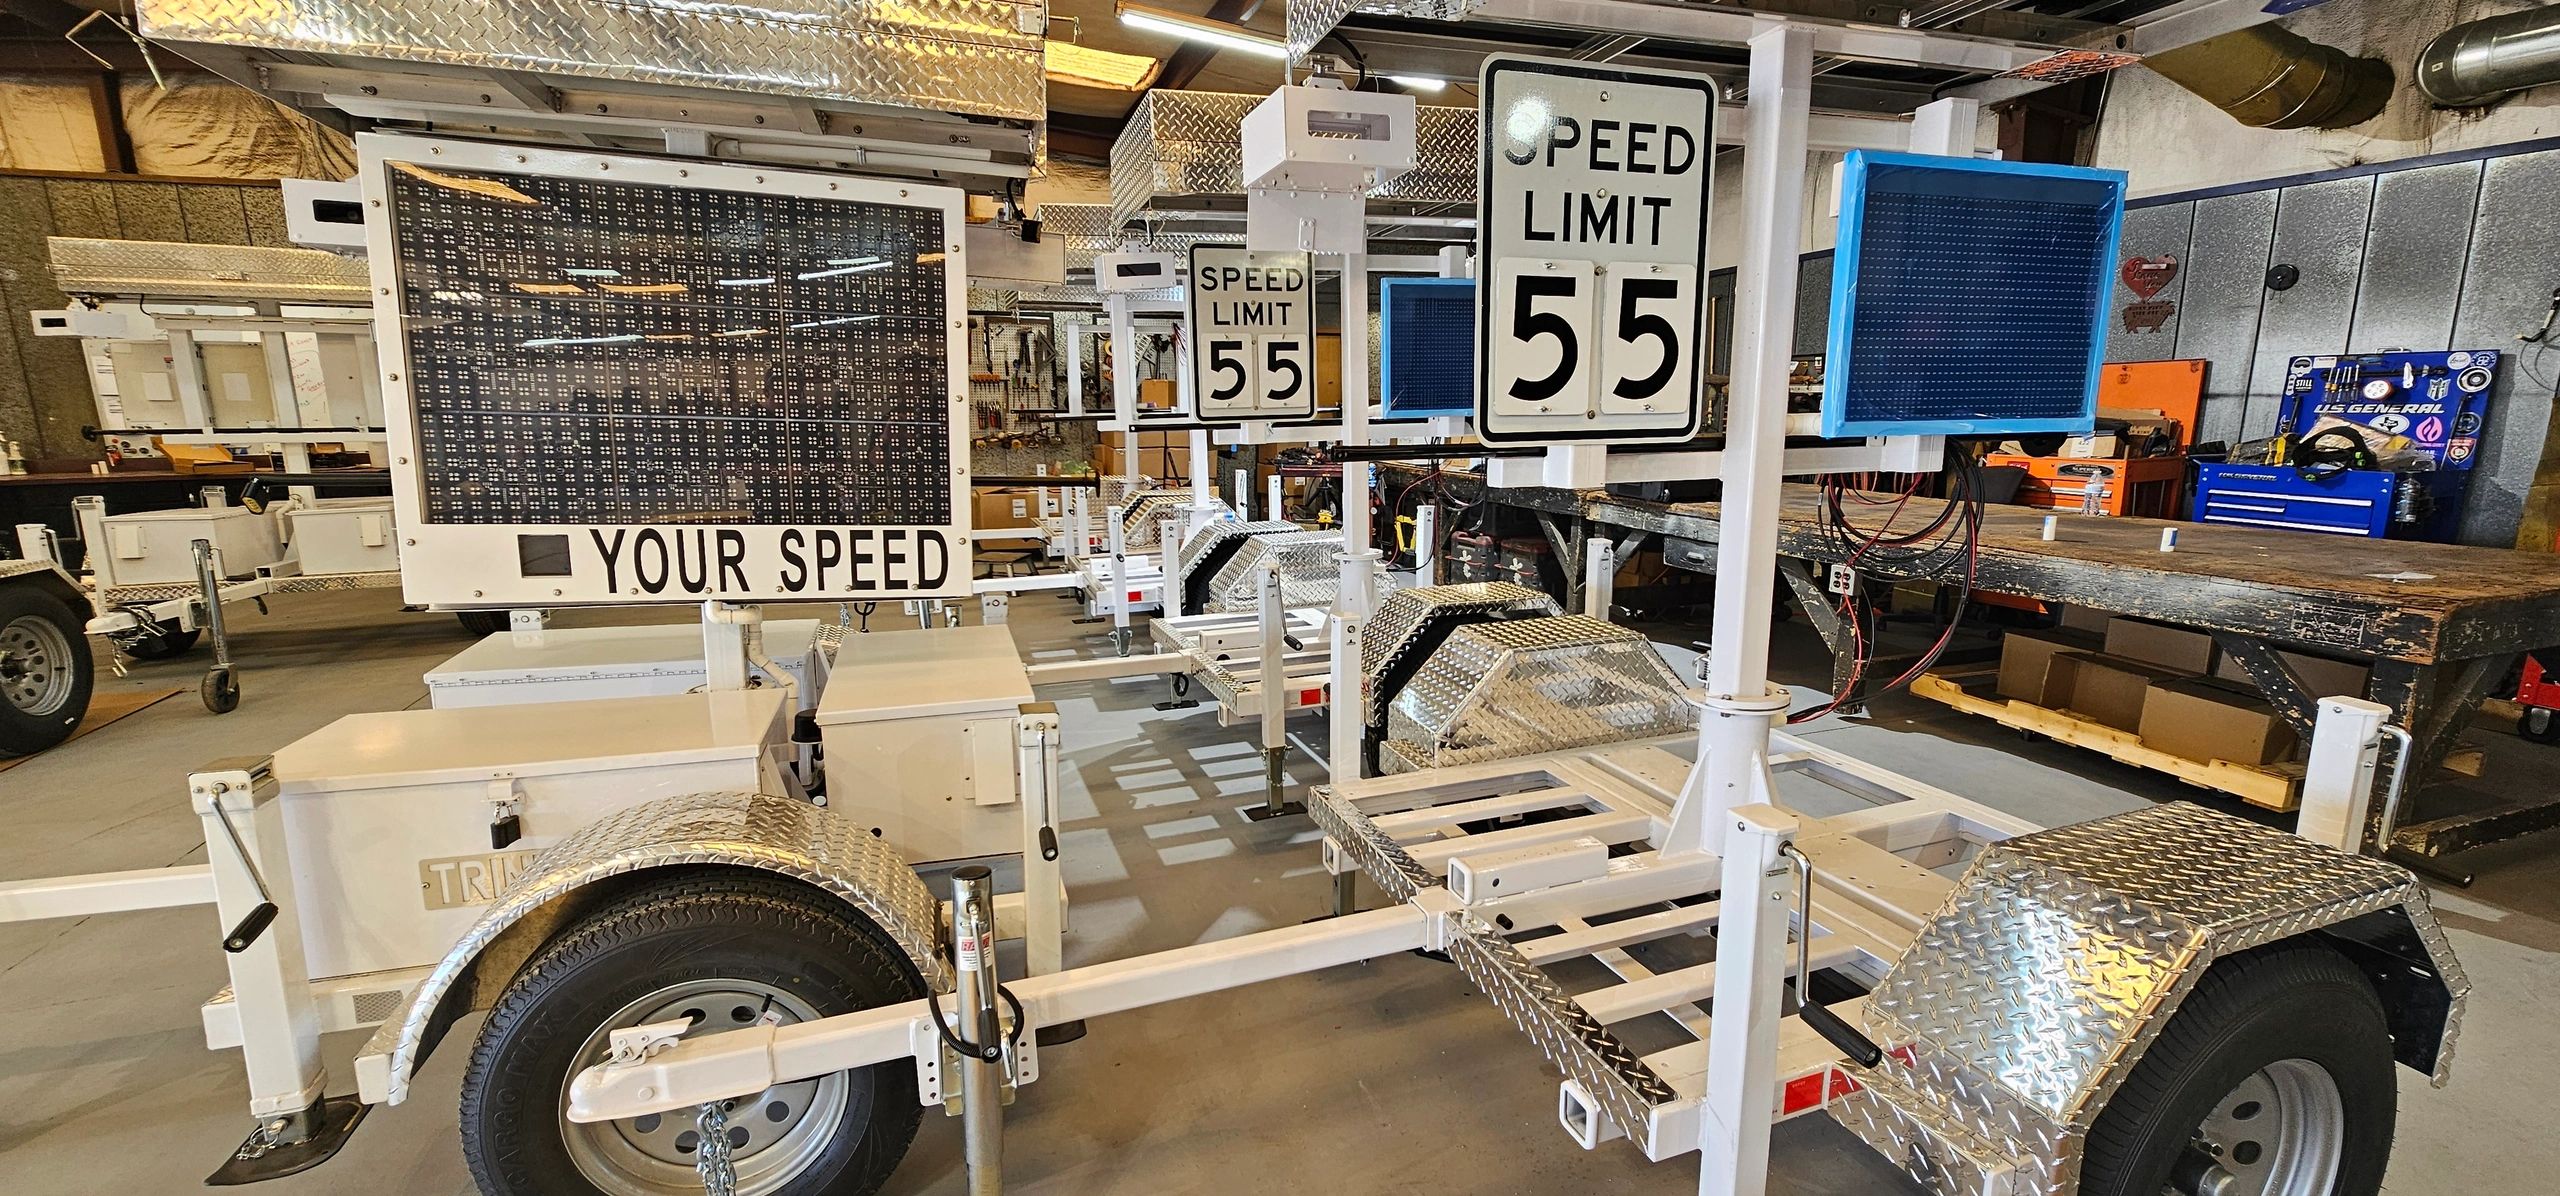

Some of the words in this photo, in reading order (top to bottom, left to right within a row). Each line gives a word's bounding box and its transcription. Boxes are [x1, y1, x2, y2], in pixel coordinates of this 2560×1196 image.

[1525, 190, 1672, 246] LIMIT
[1200, 266, 1304, 292] SPEED
[1212, 301, 1293, 326] LIMIT
[2295, 379, 2313, 387] STILL
[2346, 403, 2446, 414] GENERAL
[589, 528, 750, 594] YOUR
[780, 528, 949, 593] SPEED
